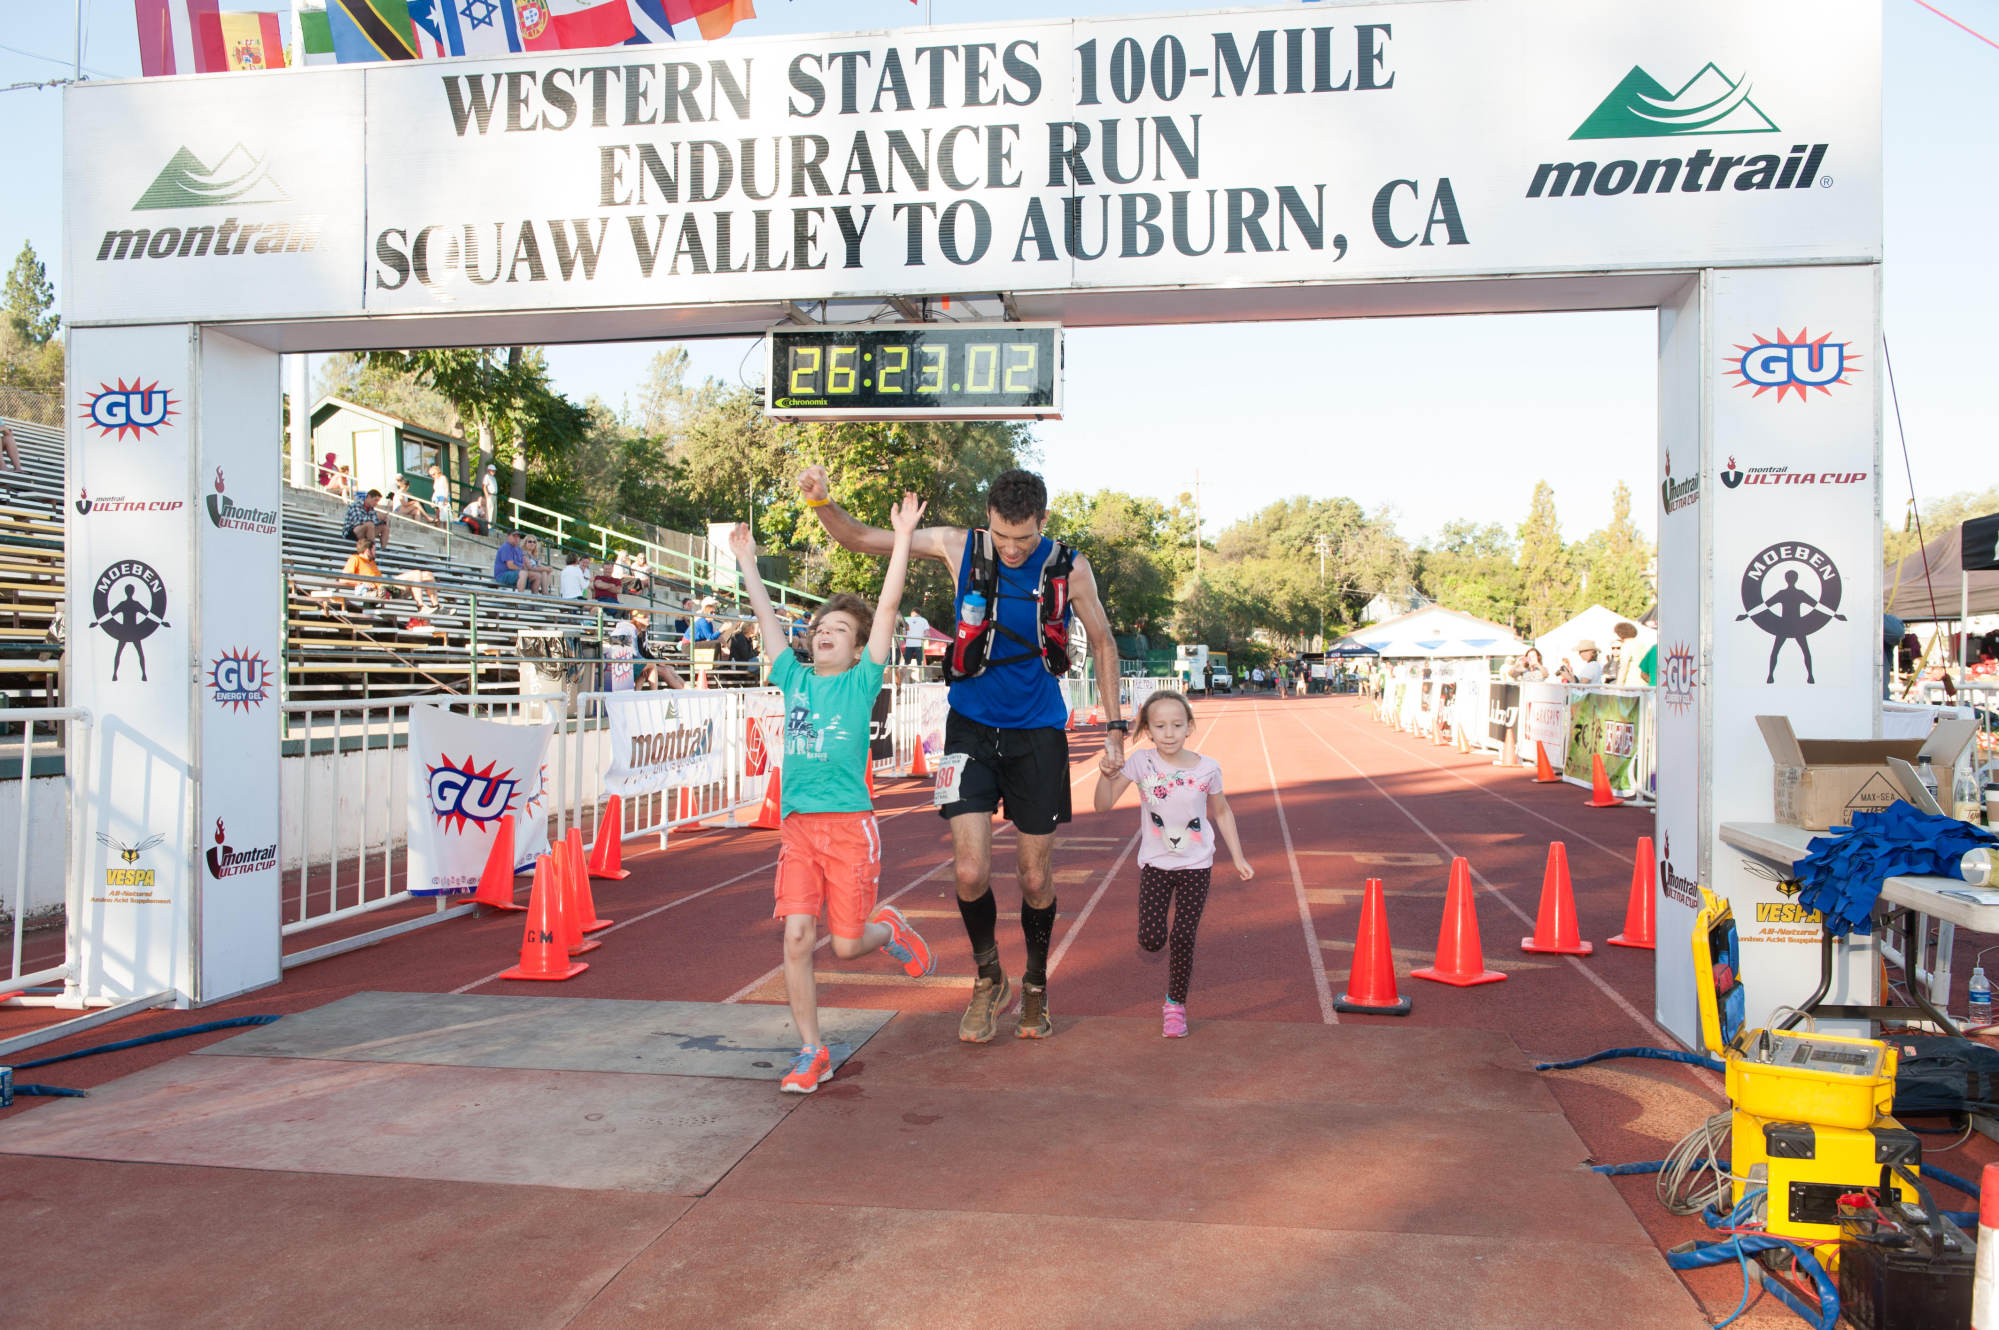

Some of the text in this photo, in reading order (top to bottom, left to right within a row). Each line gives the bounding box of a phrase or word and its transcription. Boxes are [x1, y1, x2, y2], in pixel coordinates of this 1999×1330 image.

[442, 23, 1396, 137] WESTERN STATES 100-MILE
[598, 114, 1202, 207] ENDURANCE RUN
[1526, 144, 1829, 198] montrail
[96, 212, 321, 261] montrail
[375, 177, 1470, 300] SQUAW VALLEY TO AUBURN, CA
[790, 345, 1036, 393] 26:23.02
[1741, 343, 1844, 386] GU
[91, 390, 167, 428] GU
[788, 397, 828, 407] chronomix
[1744, 472, 1867, 485] ULTRA CUP
[93, 501, 183, 512] ULTRA CUP
[221, 505, 278, 525] montrail
[219, 518, 277, 535] ULTRA CUP
[97, 563, 163, 594] MOEBEN
[1748, 546, 1836, 582] MOEBEN
[215, 657, 263, 692] GU
[1666, 656, 1691, 694] GU
[217, 692, 263, 700] ENERGY GEL
[630, 718, 714, 769] montrail
[430, 767, 516, 821] GU
[1860, 792, 1895, 802] MAX-SEA
[218, 860, 277, 878] ULTRA CUP
[222, 844, 277, 867] montrail
[106, 868, 155, 887] VESPA
[1756, 903, 1822, 923] VESPA
